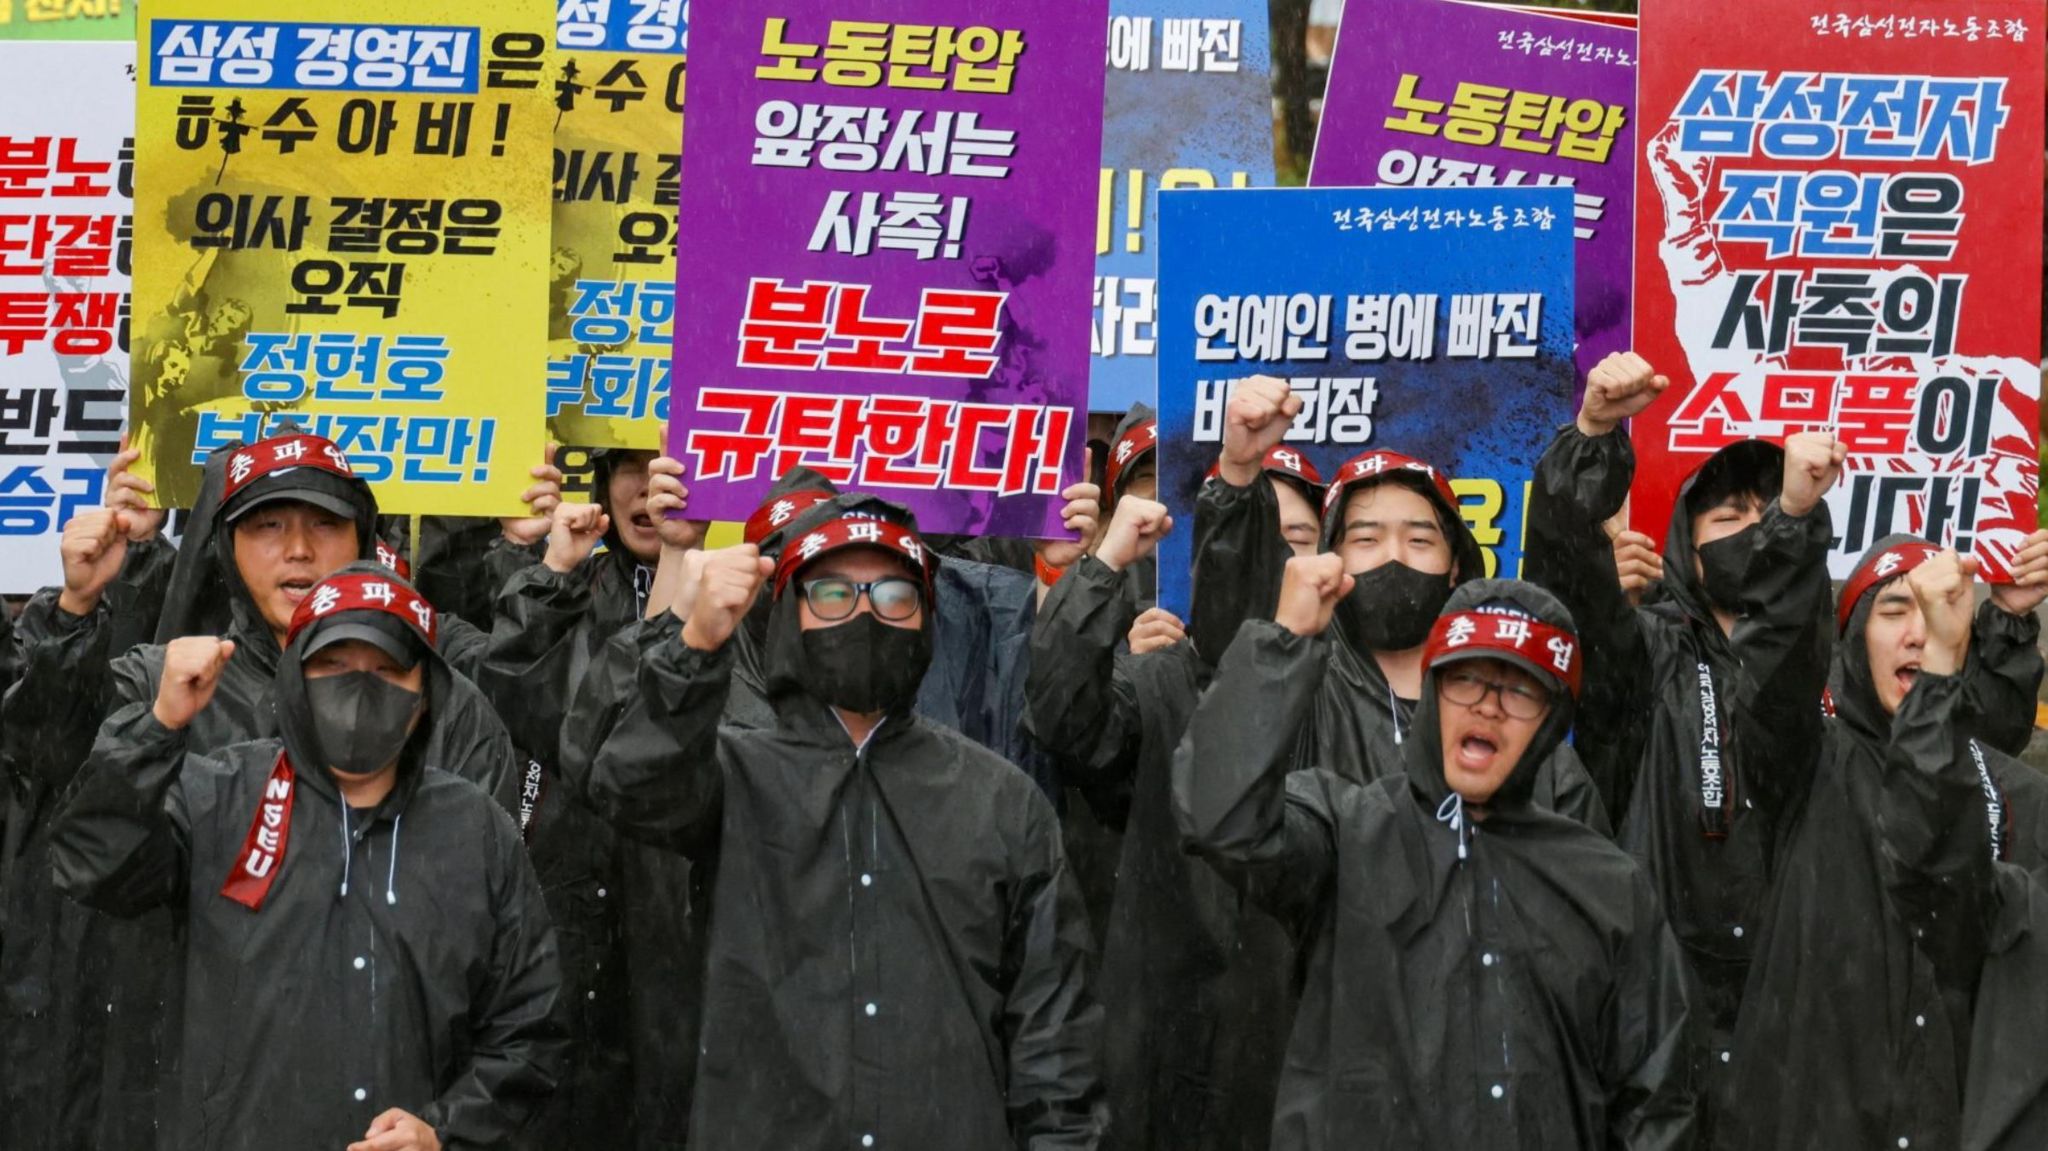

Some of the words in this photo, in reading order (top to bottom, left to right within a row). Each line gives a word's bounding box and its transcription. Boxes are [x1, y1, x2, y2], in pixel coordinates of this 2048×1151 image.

[157, 26, 275, 85] 삼성
[627, 0, 688, 49] 경
[755, 18, 1023, 94] 노동탄압
[1106, 16, 1152, 71] 에
[1161, 18, 1241, 72] 빠진
[1498, 30, 1637, 66] 전국삼성전자노
[1809, 14, 2029, 42] 전국삼성전자노동조합
[751, 100, 1016, 178] 앞장서는
[1384, 73, 1625, 163] 노동탄압
[1670, 69, 2010, 167] 삼성전자
[191, 194, 311, 252] 의사
[328, 198, 501, 256] 결정은
[612, 211, 679, 264] 오
[808, 190, 969, 260] 사측!
[1332, 205, 1556, 232] 전국삼성전자노동조합
[1712, 170, 1964, 261] 직원은
[285, 260, 406, 318] 오직
[1710, 270, 1968, 358] 사측의
[736, 277, 1009, 379] 분노로
[1194, 293, 1332, 362] 연예인
[1344, 293, 1438, 361] 병에
[1447, 292, 1541, 359] 빠진
[240, 331, 453, 402] 정현호
[546, 353, 672, 421] 부회
[687, 386, 1073, 498] 규탄한다!
[1667, 371, 1999, 459] 소모품이
[228, 440, 350, 484] 총파업
[798, 523, 924, 566] 총파업
[311, 582, 431, 633] 총파업
[1446, 615, 1574, 673] 총파업
[245, 777, 290, 877] NSEU
